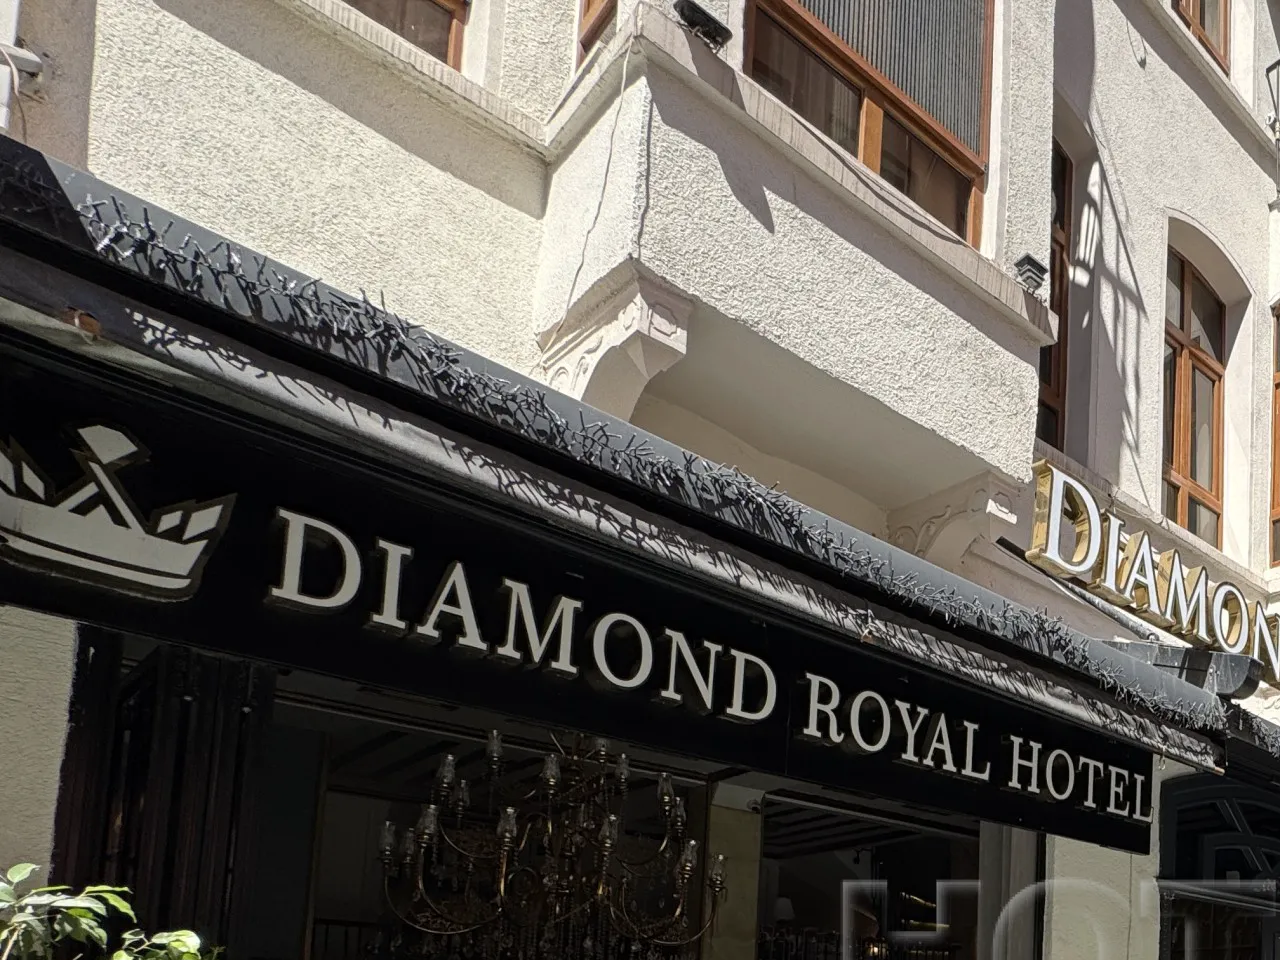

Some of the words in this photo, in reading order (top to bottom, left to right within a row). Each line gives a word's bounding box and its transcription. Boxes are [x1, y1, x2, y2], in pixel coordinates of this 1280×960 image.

[269, 506, 779, 723] DIAMOND
[803, 671, 992, 782] ROYAL
[1007, 734, 1154, 824] HOTEL
